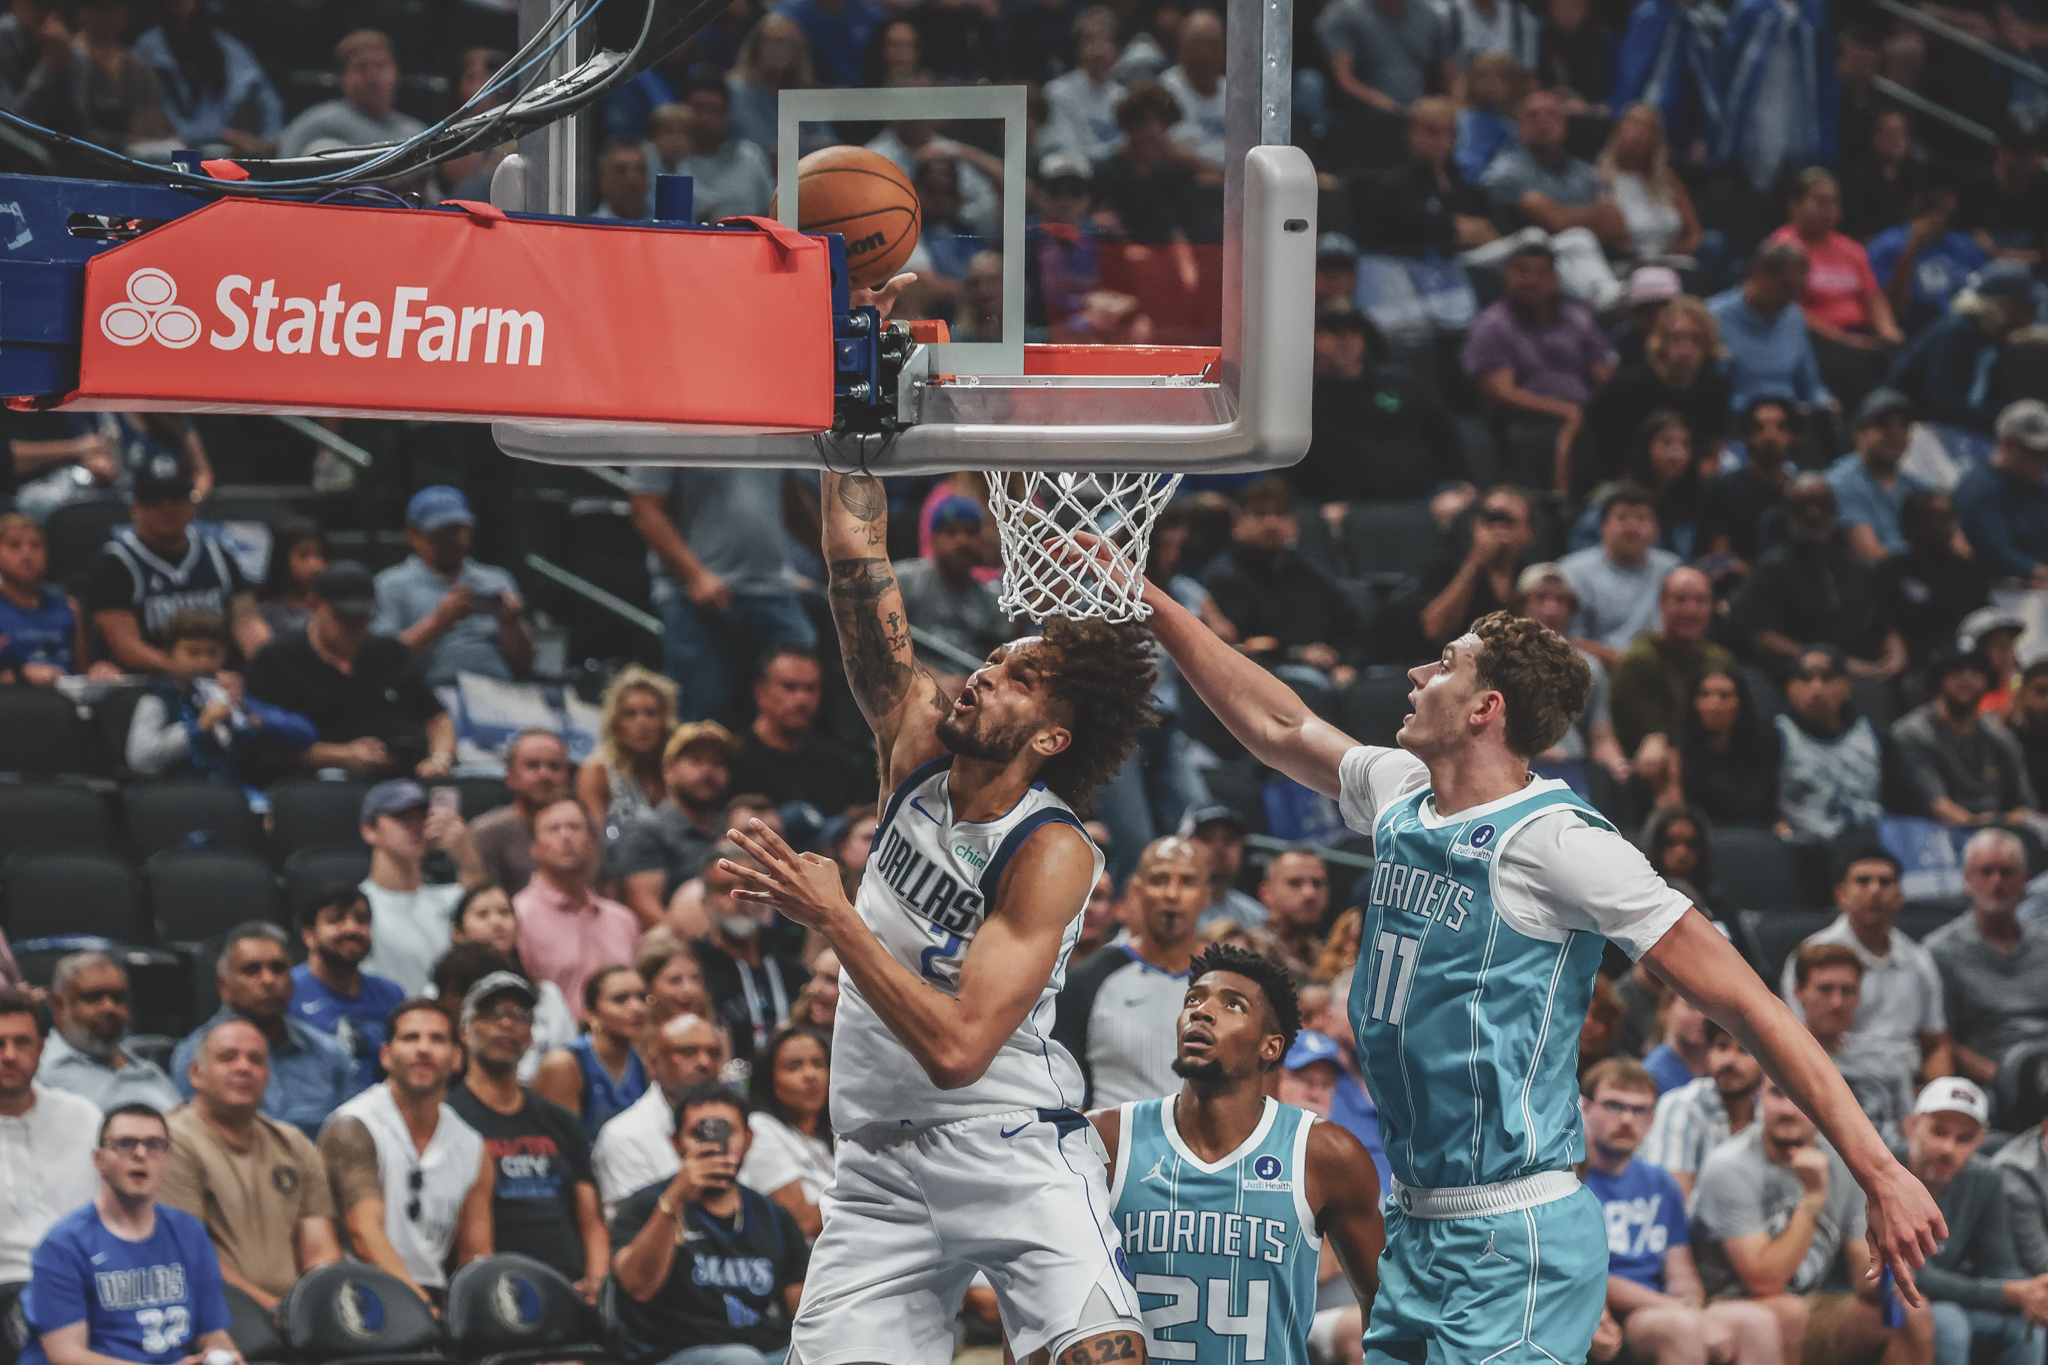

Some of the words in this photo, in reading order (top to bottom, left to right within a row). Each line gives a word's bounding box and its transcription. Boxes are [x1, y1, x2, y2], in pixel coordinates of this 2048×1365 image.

[877, 824, 984, 934] DALLAS
[954, 844, 987, 871] chim
[1370, 862, 1475, 933] ORNETS
[1371, 930, 1420, 1026] 11
[1244, 1181, 1264, 1190] Judi
[1265, 1182, 1291, 1191] Health
[1124, 1209, 1289, 1264] HORNETS
[95, 1262, 189, 1312] DALLAS
[136, 1305, 191, 1354] 32
[1135, 1272, 1270, 1362] 24
